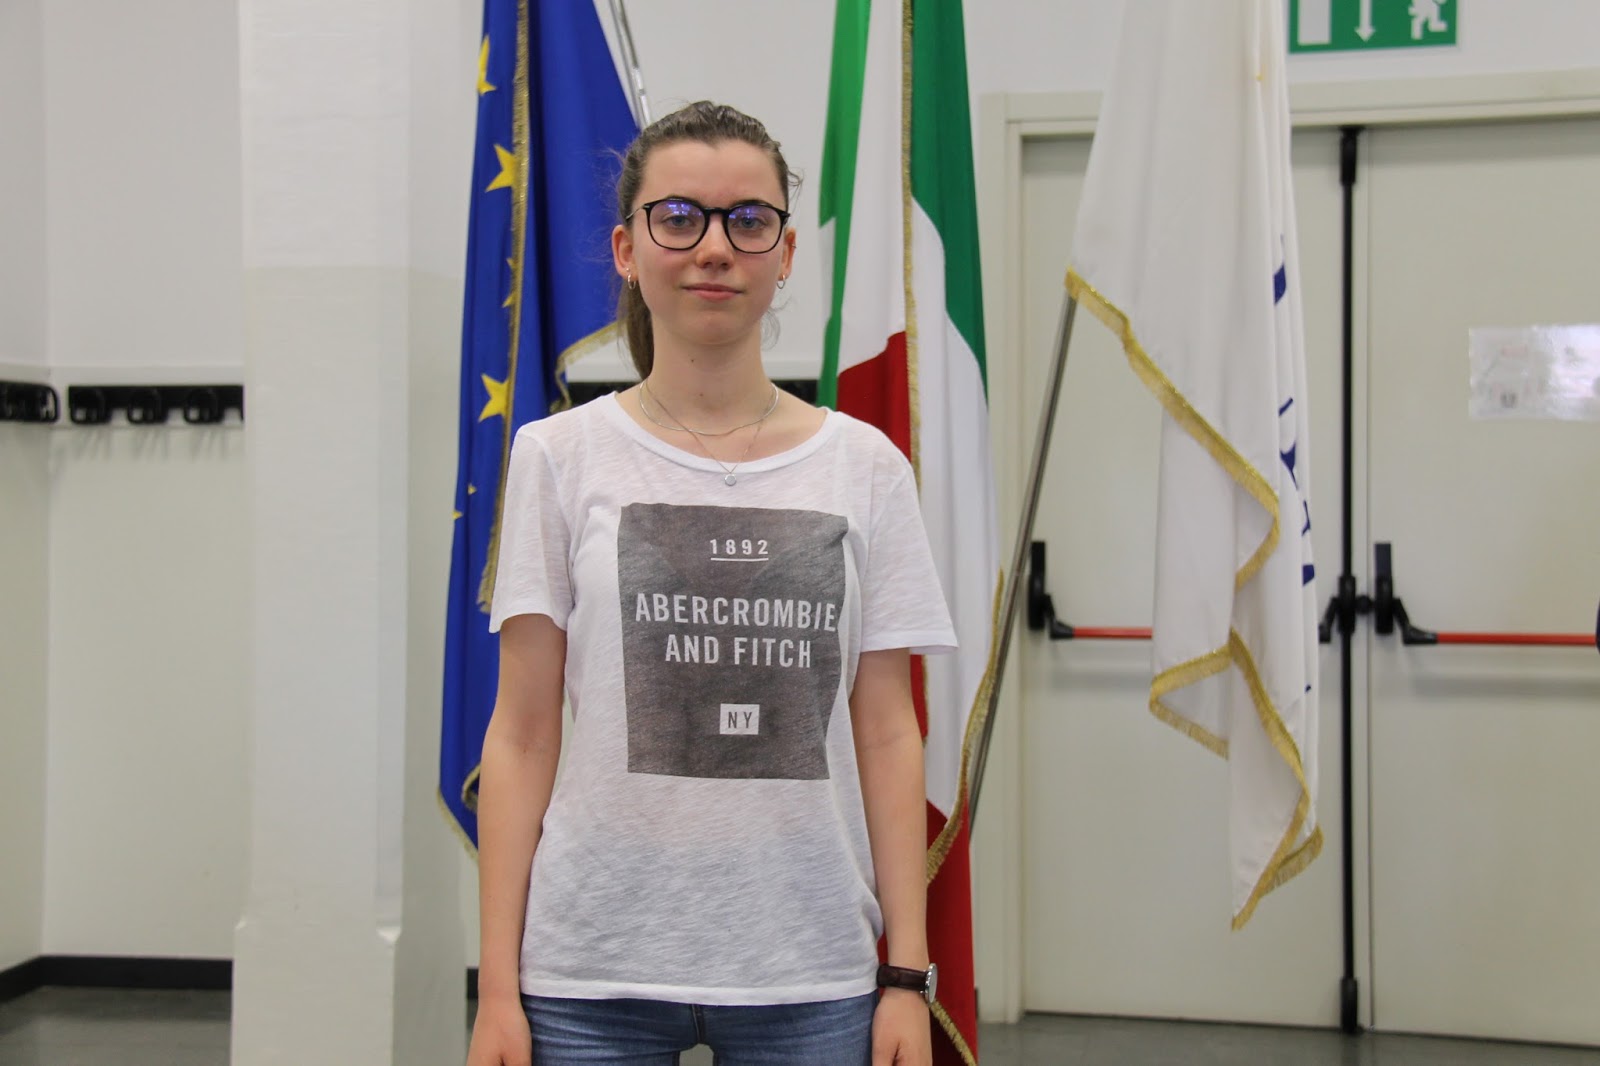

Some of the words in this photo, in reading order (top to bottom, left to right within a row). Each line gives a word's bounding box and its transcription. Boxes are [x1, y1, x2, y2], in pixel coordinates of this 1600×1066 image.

[710, 539, 768, 555] 1892
[635, 593, 836, 632] ABERCROMBIE
[665, 634, 719, 664] AND
[734, 637, 811, 668] FITCH
[728, 711, 753, 729] NY
